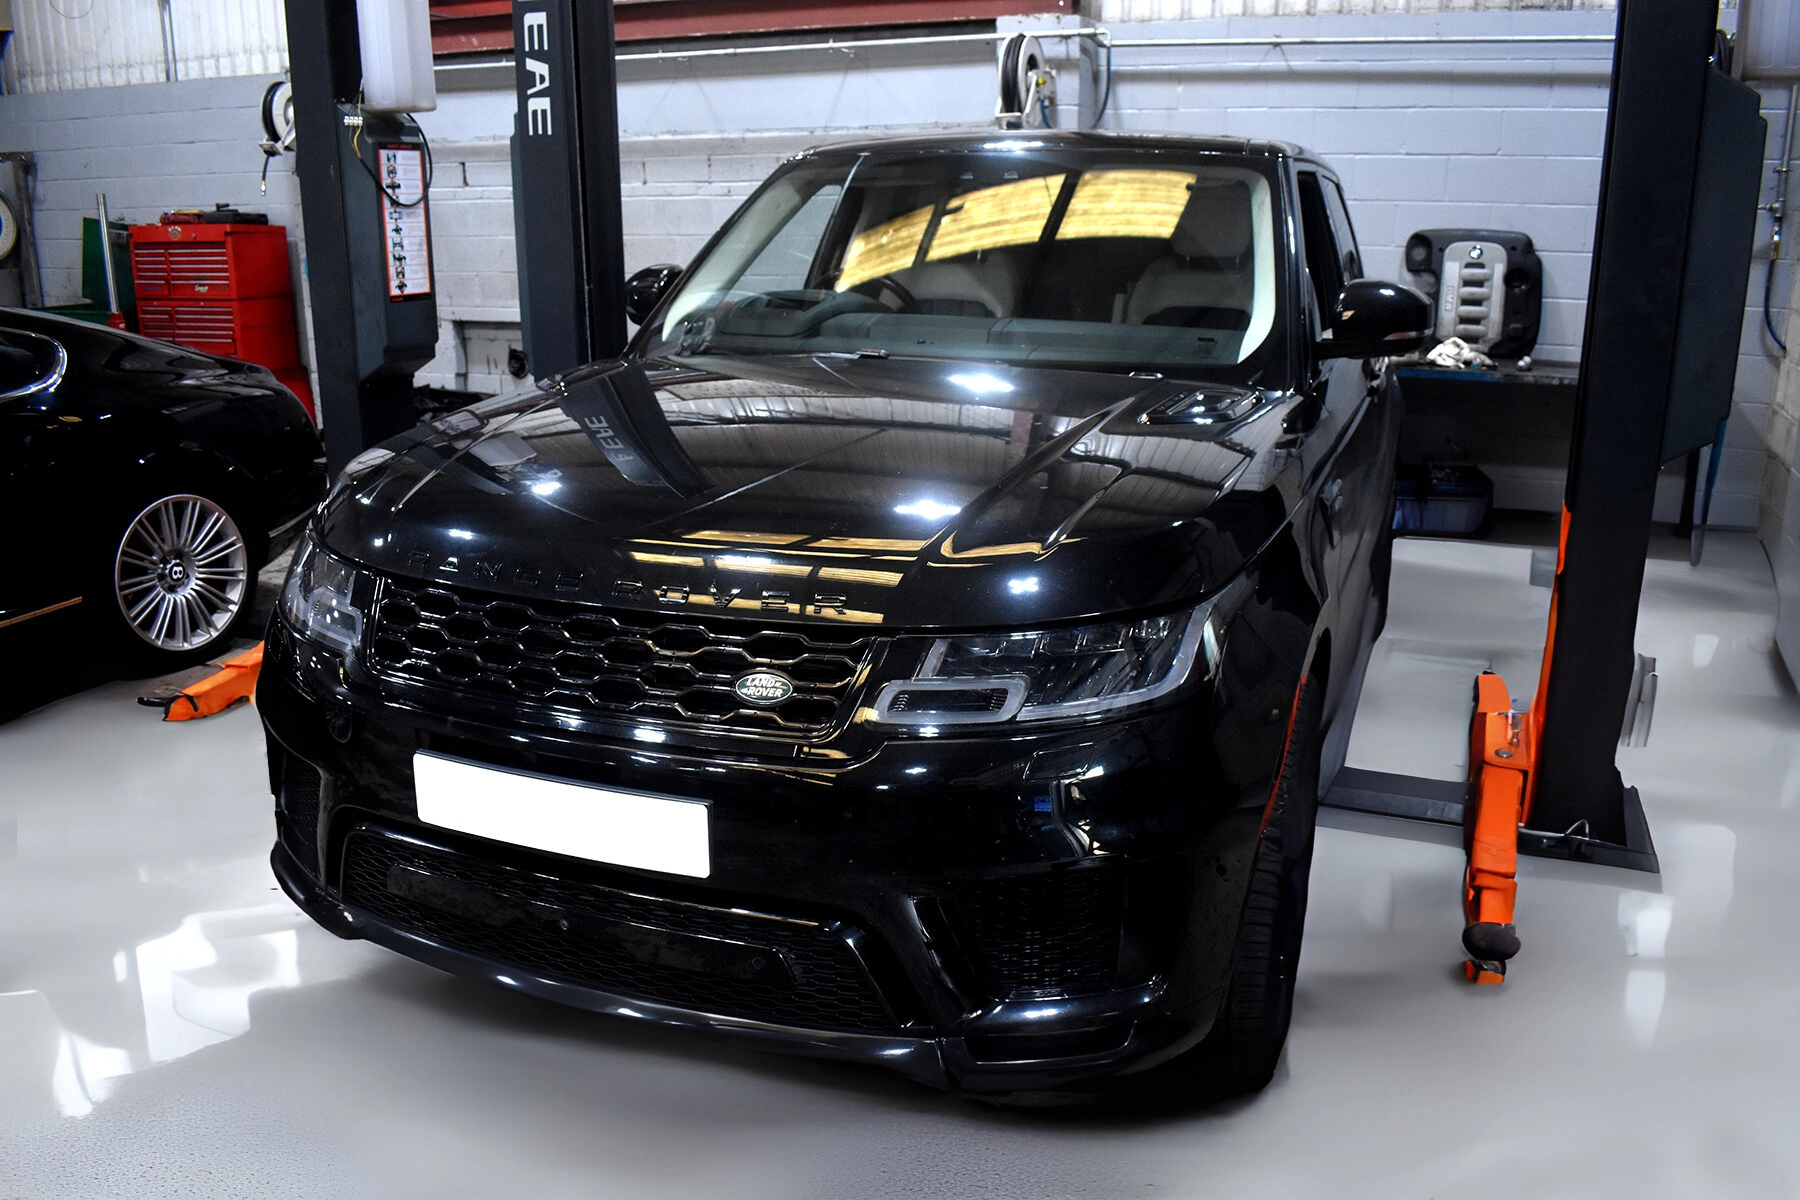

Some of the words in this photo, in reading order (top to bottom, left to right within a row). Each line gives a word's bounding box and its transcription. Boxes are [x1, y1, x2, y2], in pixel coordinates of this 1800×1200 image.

[524, 11, 552, 136] EAE
[611, 580, 848, 616] ROVER
[745, 677, 775, 687] LAND
[747, 687, 783, 698] ROVER
